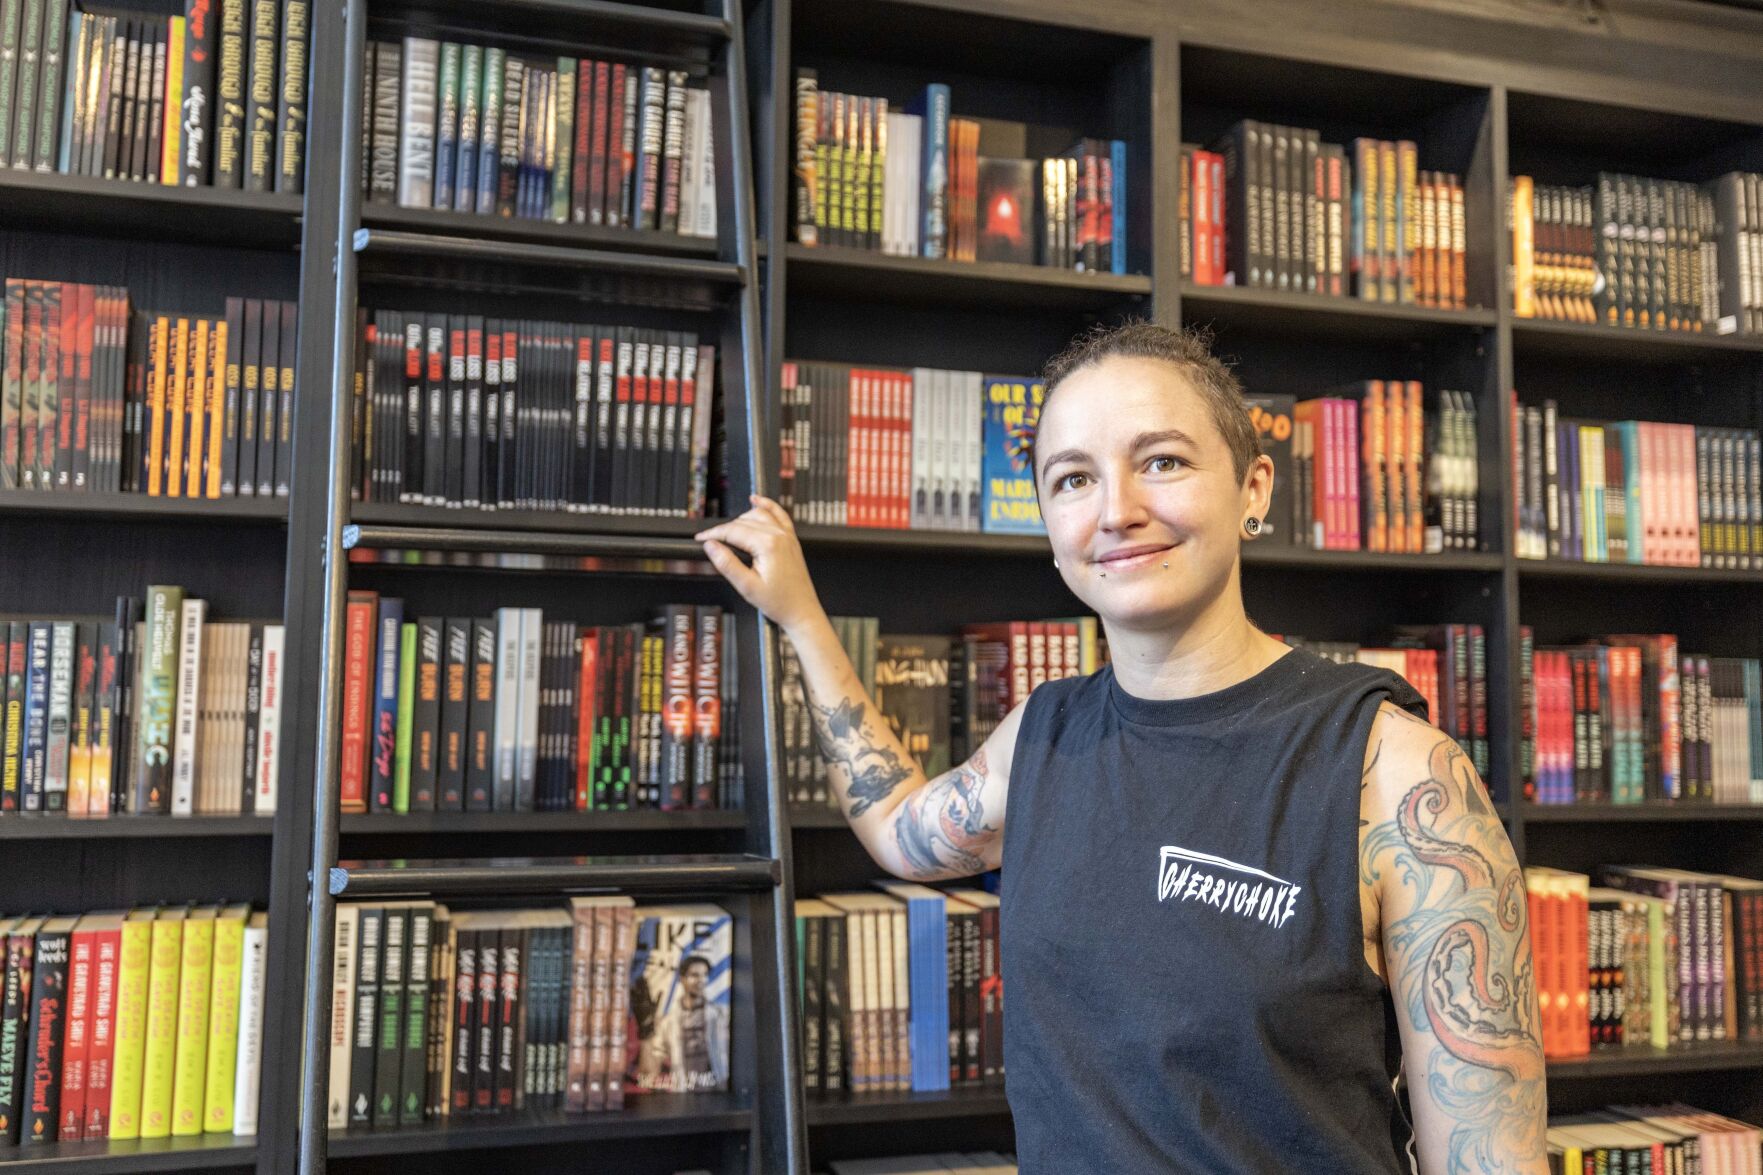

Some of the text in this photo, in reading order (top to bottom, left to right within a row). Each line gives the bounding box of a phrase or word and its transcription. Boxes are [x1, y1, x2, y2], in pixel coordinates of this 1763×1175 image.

[223, 0, 243, 33] EIGH
[372, 76, 398, 191] NINTH HOUSE
[404, 62, 435, 179] HELL BENT
[501, 61, 523, 168] DEAD SILENCE
[990, 479, 1035, 498] MARI
[29, 628, 48, 748] NEAR THE BONE
[51, 626, 71, 716] HORSEMAN
[0, 1018, 18, 1073] MAEVE
[70, 943, 90, 1048] THE GRAVEYARD SHIFT
[95, 942, 114, 1046] THE GRAVEYARD SHIFT
[0, 1075, 13, 1106] FLY
